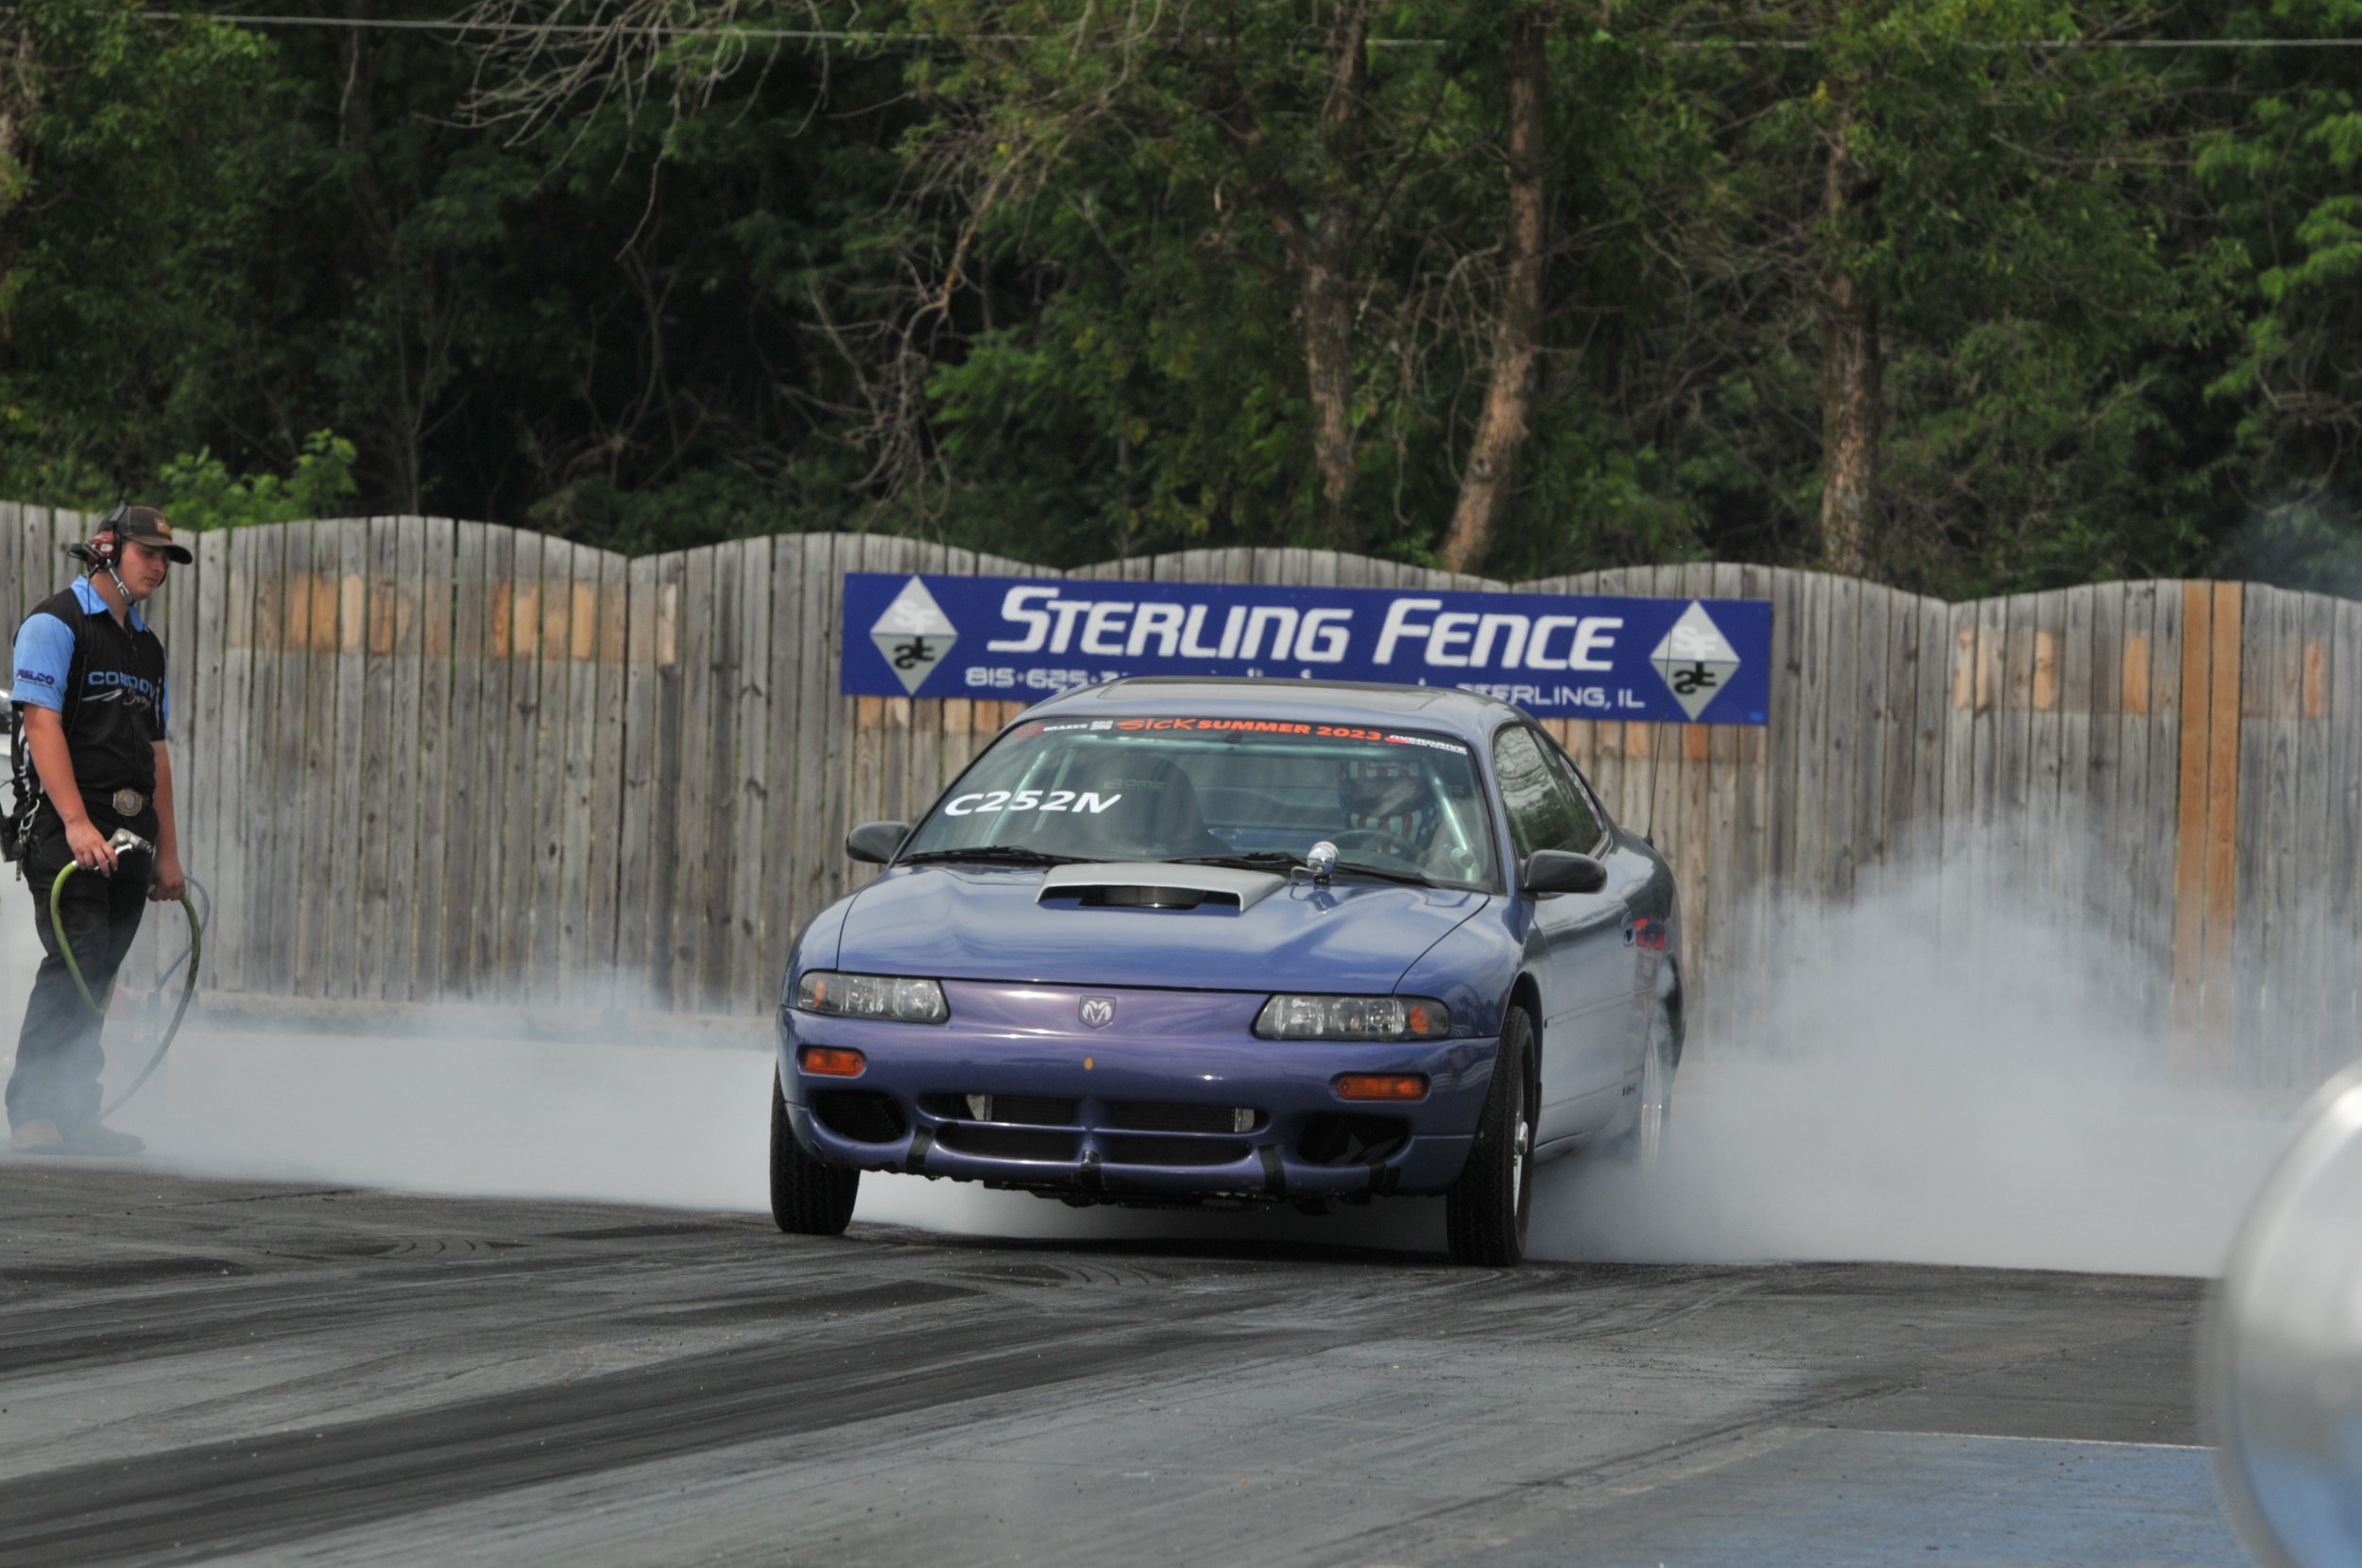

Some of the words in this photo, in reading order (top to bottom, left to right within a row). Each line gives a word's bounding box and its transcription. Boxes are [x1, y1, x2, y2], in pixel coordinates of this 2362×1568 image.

[986, 585, 1352, 663] STERLING
[1372, 597, 1625, 671] FENCE
[1617, 689, 1646, 708] IL
[1197, 720, 1310, 735] SUMMER
[1316, 725, 1382, 741] 2023
